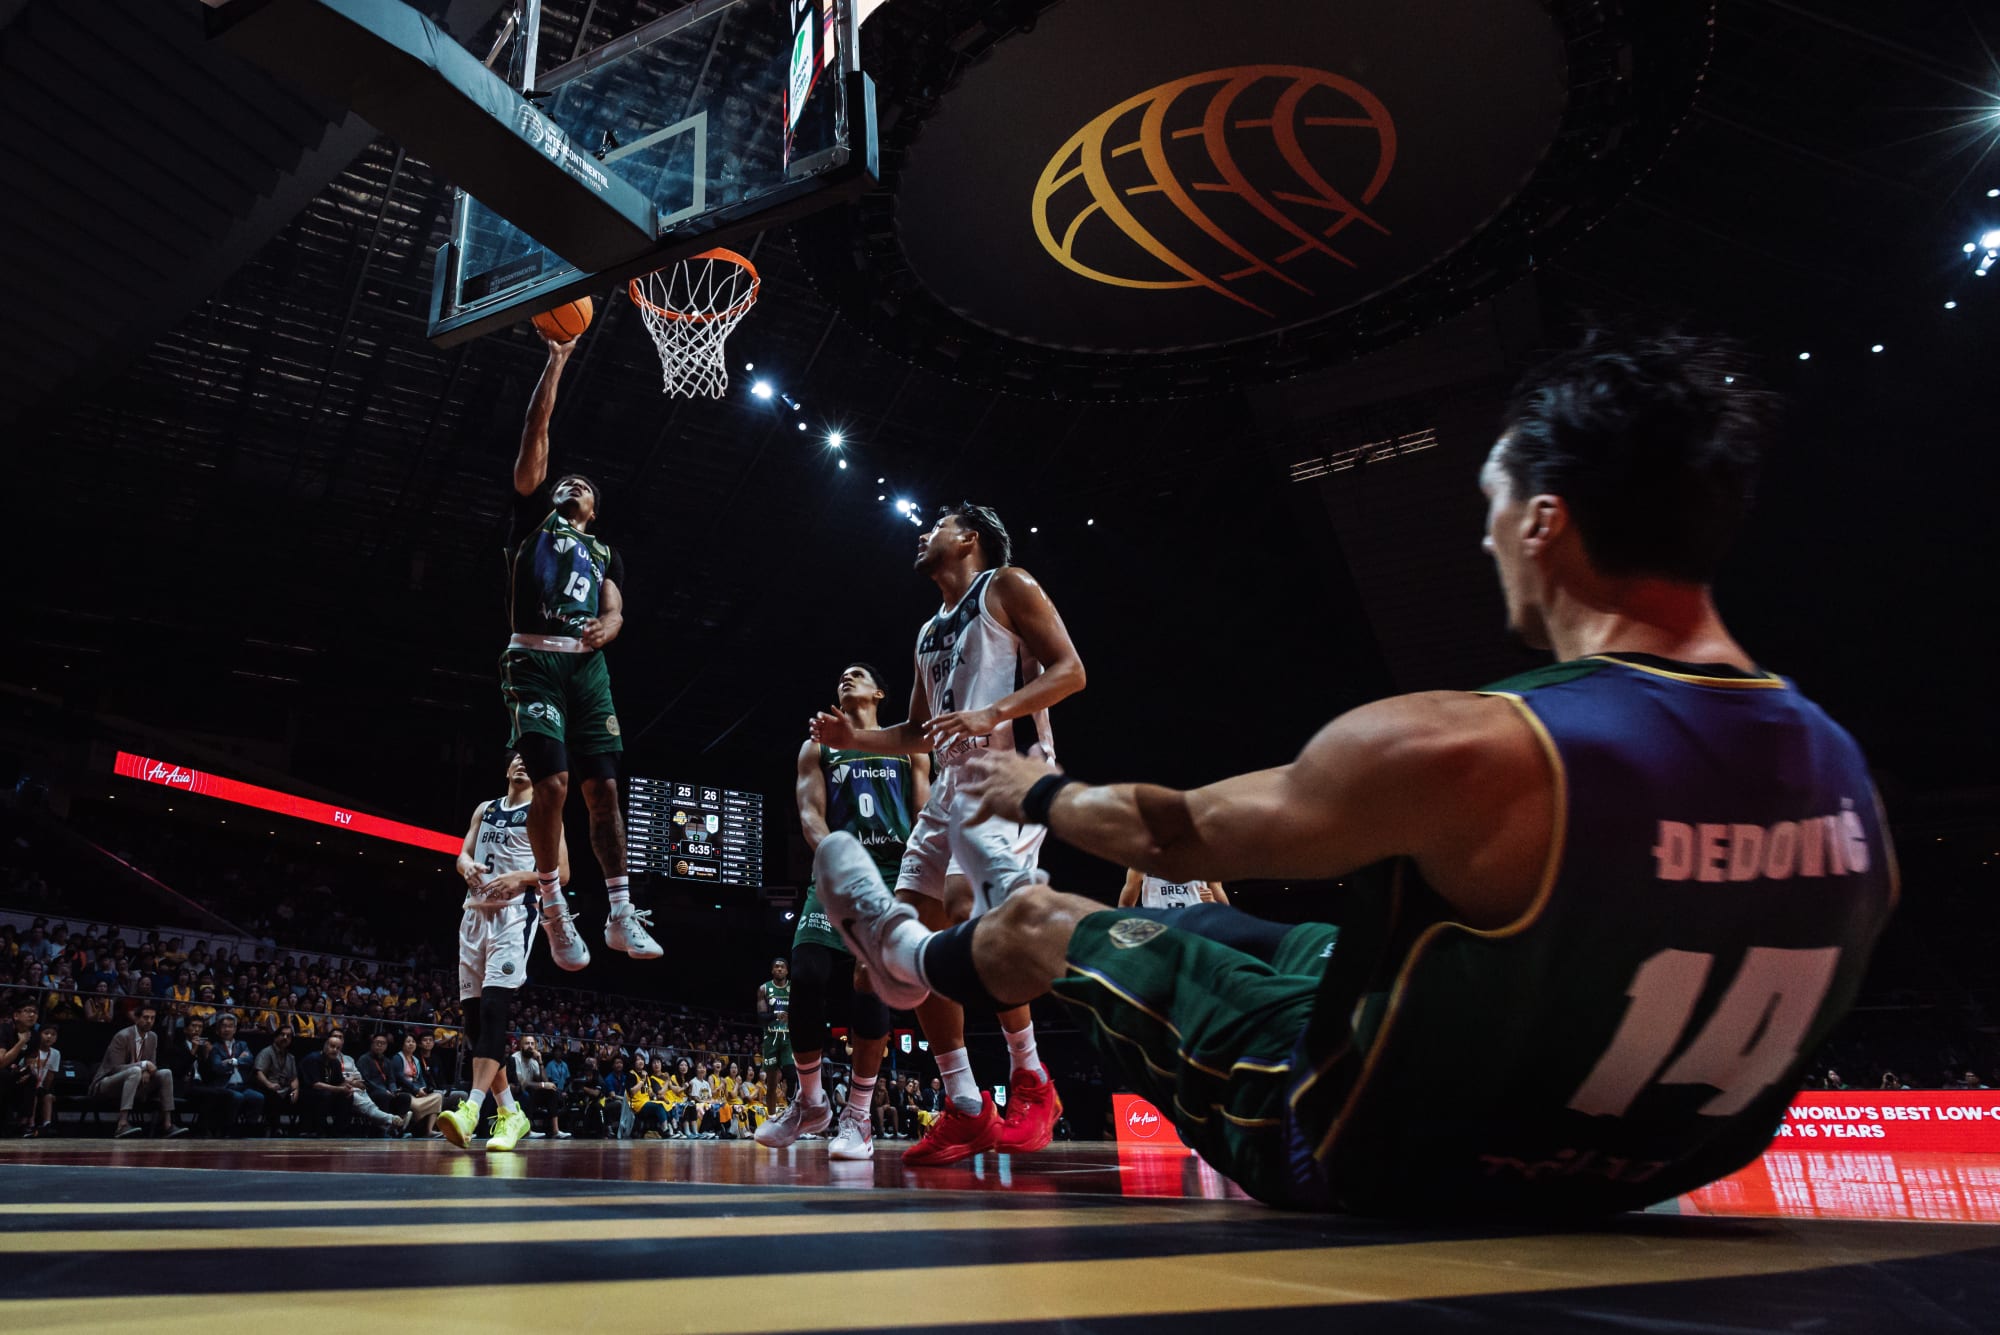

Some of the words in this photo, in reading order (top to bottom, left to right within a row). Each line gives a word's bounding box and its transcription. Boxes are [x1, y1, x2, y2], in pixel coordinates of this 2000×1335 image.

[545, 142, 559, 160] CUP
[563, 570, 591, 603] 13
[931, 647, 967, 685] BREX
[852, 766, 897, 781] Unicaja
[678, 786, 691, 798] 25
[704, 790, 717, 801] 26
[859, 792, 875, 818] 0
[334, 811, 353, 826] FLY
[481, 831, 510, 847] BREX
[688, 843, 710, 855] 6:35
[1160, 885, 1190, 896] BREX
[1567, 945, 1842, 1117] 14
[1789, 1106, 1879, 1120] WORLD'S
[1881, 1106, 1931, 1120] BEST
[1796, 1124, 1818, 1137] 16
[1820, 1124, 1885, 1138] YEARS
